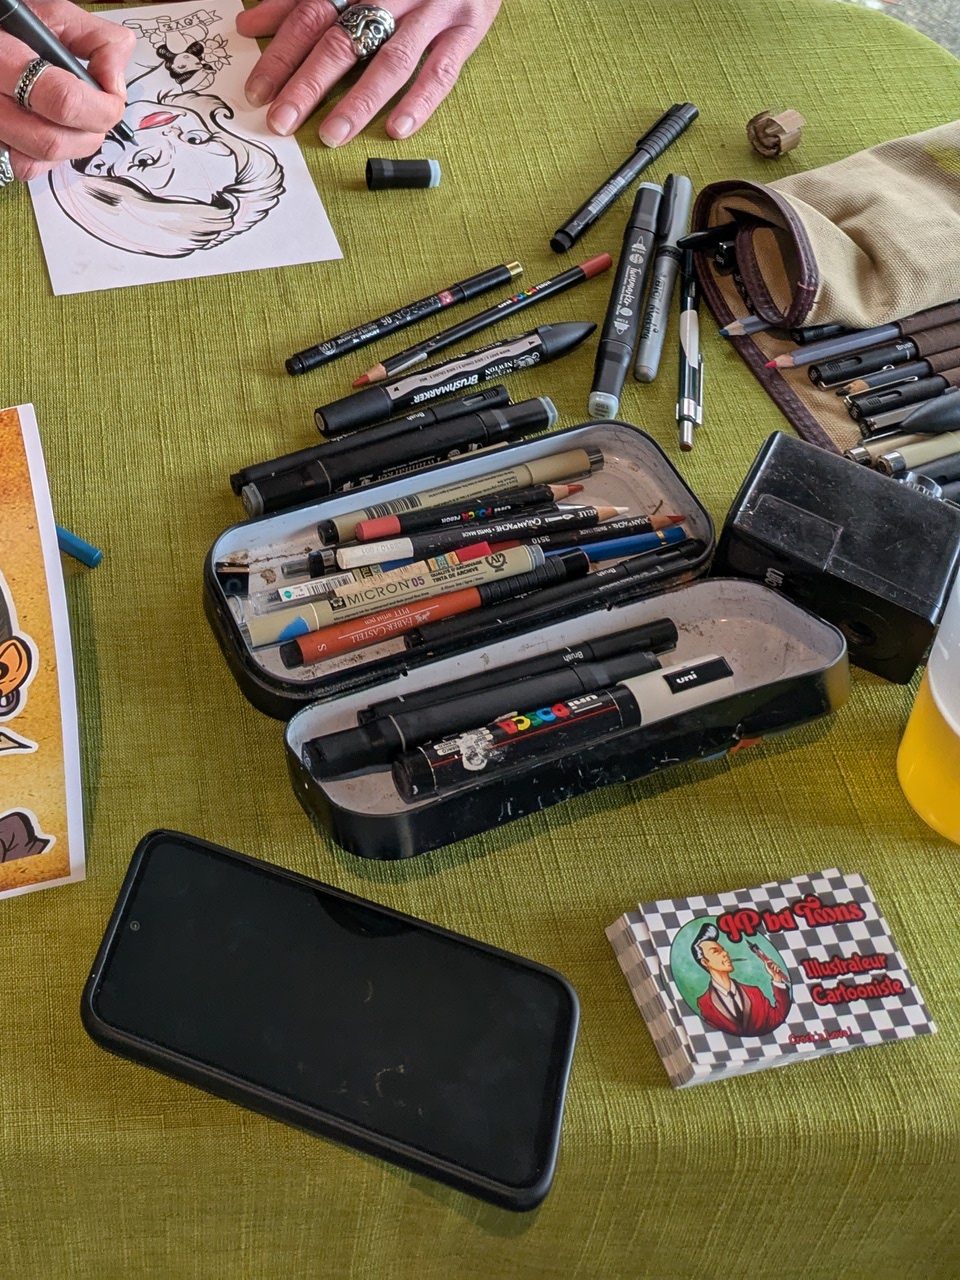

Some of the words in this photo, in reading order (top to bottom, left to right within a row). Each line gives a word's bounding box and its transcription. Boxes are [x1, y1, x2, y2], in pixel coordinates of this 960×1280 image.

[163, 14, 200, 31] LOVE
[485, 359, 514, 377] NEWTON
[431, 574, 448, 583] TINTA
[456, 566, 480, 578] ARCHIVE
[347, 580, 411, 606] MICRON
[411, 576, 426, 587] 05
[364, 616, 378, 625] pen
[392, 607, 410, 617] PITT
[349, 616, 414, 643] FABER-CASTELL
[563, 651, 584, 662] Brush
[676, 670, 697, 684] uni
[567, 694, 598, 710] uni
[496, 703, 571, 734] POSCA
[793, 893, 866, 928] Toons
[801, 952, 888, 981] Illustrateur
[810, 976, 905, 1006] Cartooniste
